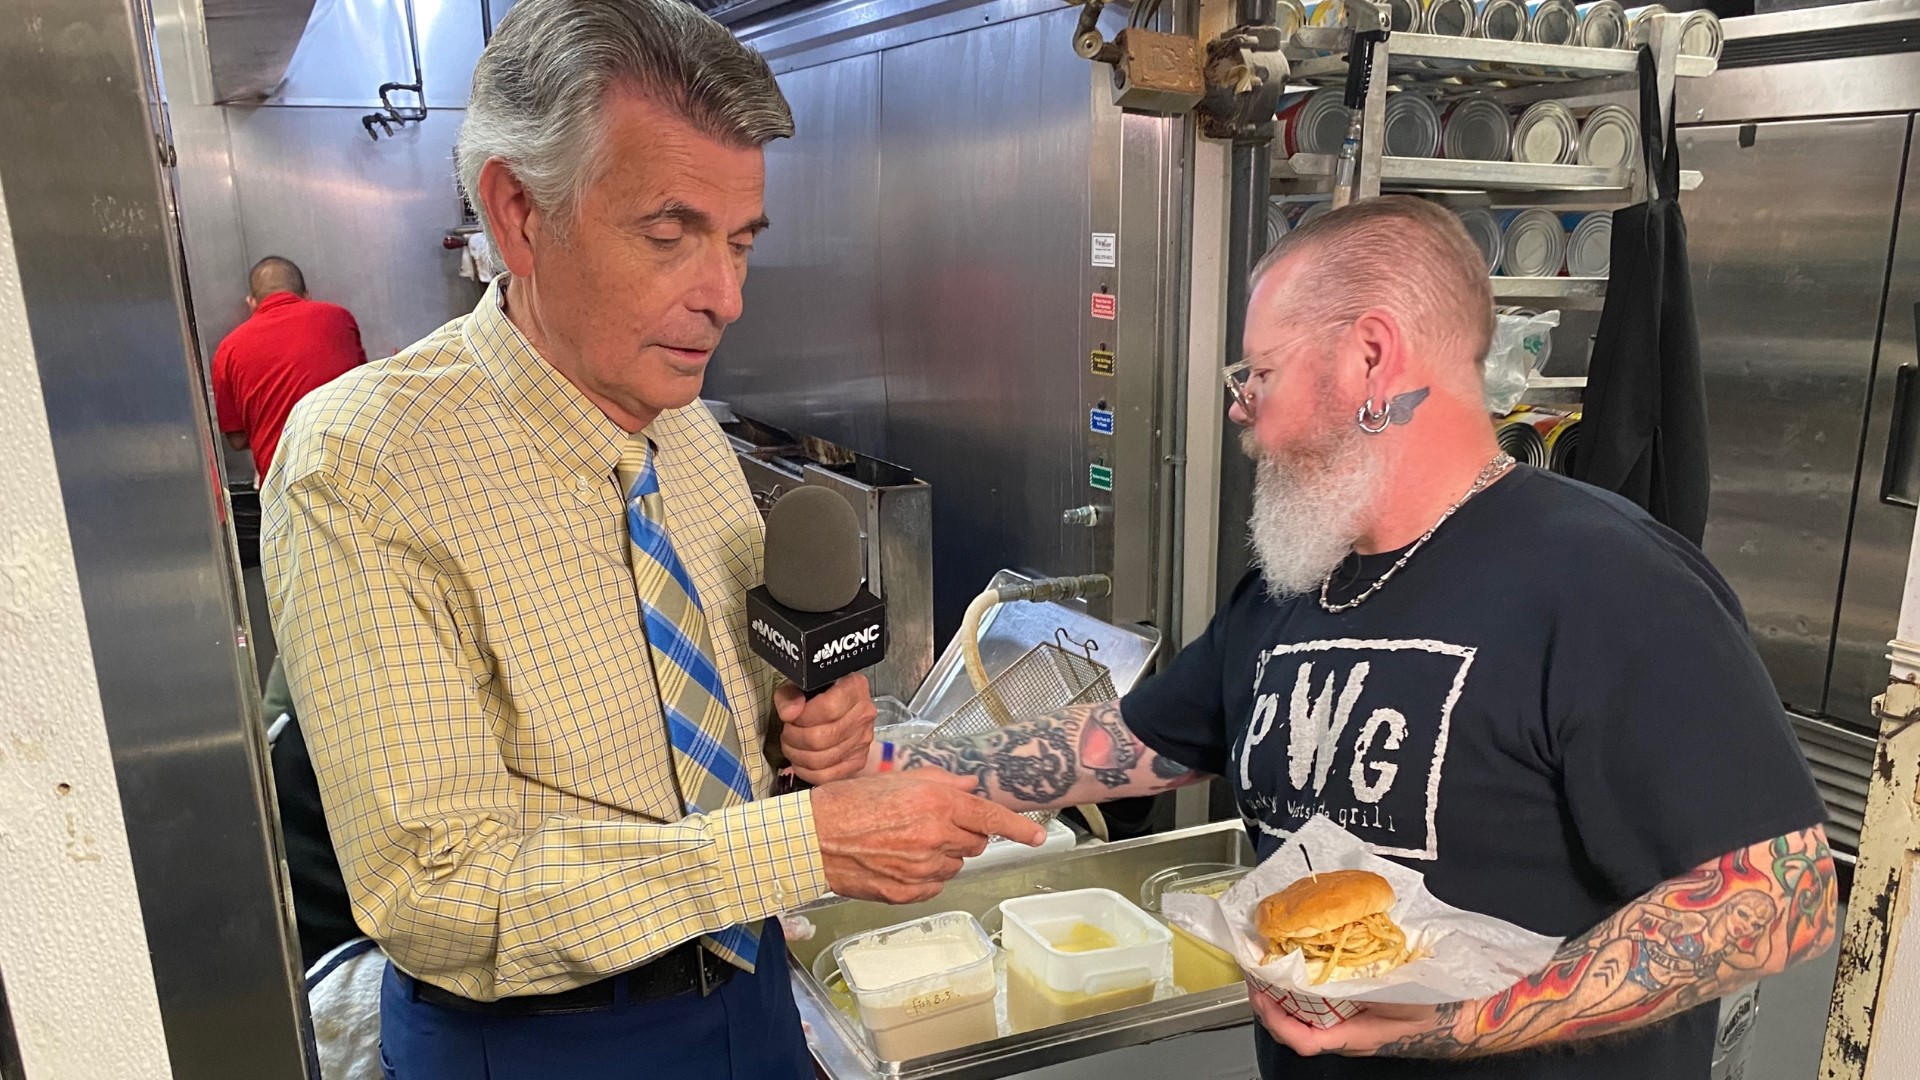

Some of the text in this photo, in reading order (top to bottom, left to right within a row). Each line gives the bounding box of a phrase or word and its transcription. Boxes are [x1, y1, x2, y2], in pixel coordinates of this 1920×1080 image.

[756, 635, 797, 668] CHARLOTTE
[758, 619, 800, 661] WCNC
[819, 643, 877, 669] CHARLOTTE
[822, 624, 880, 658] WCNC
[1338, 805, 1396, 832] grill
